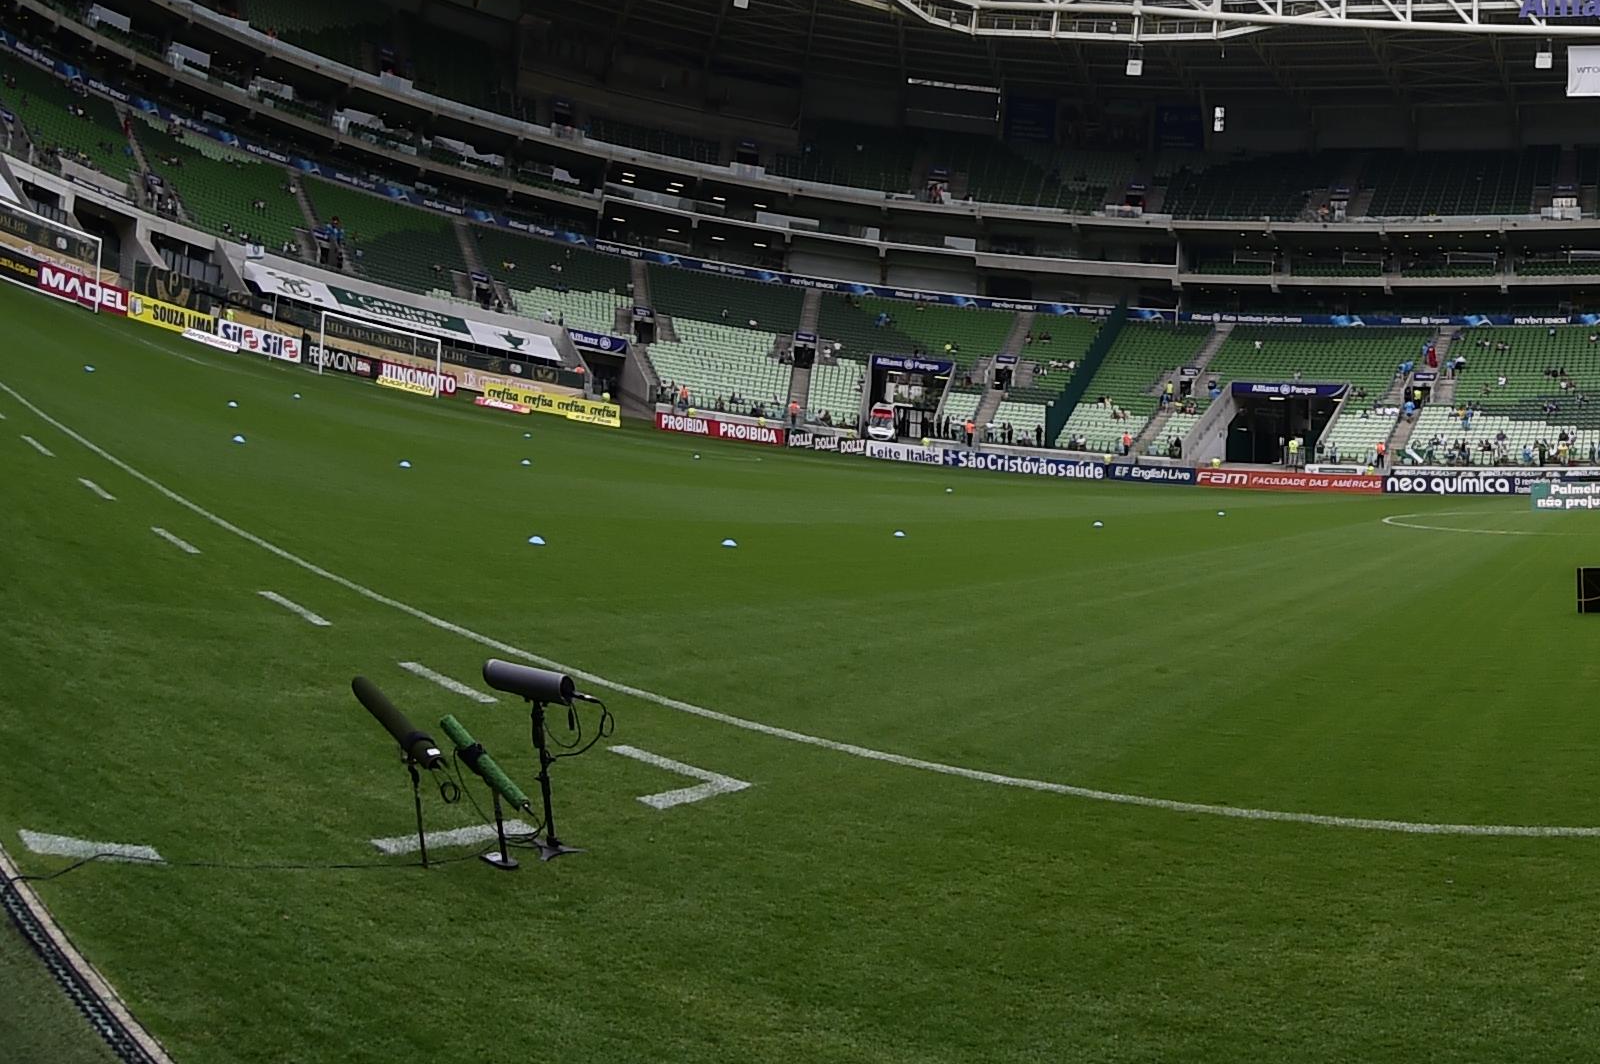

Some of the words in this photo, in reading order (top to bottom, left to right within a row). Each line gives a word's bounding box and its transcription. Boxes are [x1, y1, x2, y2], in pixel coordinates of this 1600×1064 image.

[41, 265, 128, 312] MADEL
[152, 303, 186, 329] SOUZA
[187, 314, 213, 336] LIMA
[222, 323, 243, 342] Sil
[262, 333, 283, 356] Sil
[570, 331, 599, 346] Allianz
[1252, 384, 1279, 394] Allianz
[1290, 385, 1317, 395] Parque
[487, 387, 519, 404] crefisa
[523, 393, 553, 409] crefisa
[557, 400, 586, 415] crefisa
[589, 406, 617, 420] crefisa
[789, 433, 814, 447] DOLLY
[814, 436, 839, 450] DOLLY
[840, 439, 866, 453] DOLLY
[870, 445, 901, 460] Leite
[906, 449, 940, 463] Italac
[958, 452, 986, 470] São
[987, 454, 1057, 477] Cristóvão
[1057, 460, 1104, 479] saúde
[1114, 466, 1129, 477] EF
[1131, 466, 1167, 481] English
[1168, 469, 1191, 481] Live
[1251, 476, 1307, 486] FACULDADE
[1308, 478, 1329, 487] DAS
[1332, 477, 1382, 489] AMÉRICAS
[1387, 477, 1427, 492] neo
[1430, 475, 1510, 495] química
[1537, 496, 1563, 508] não
